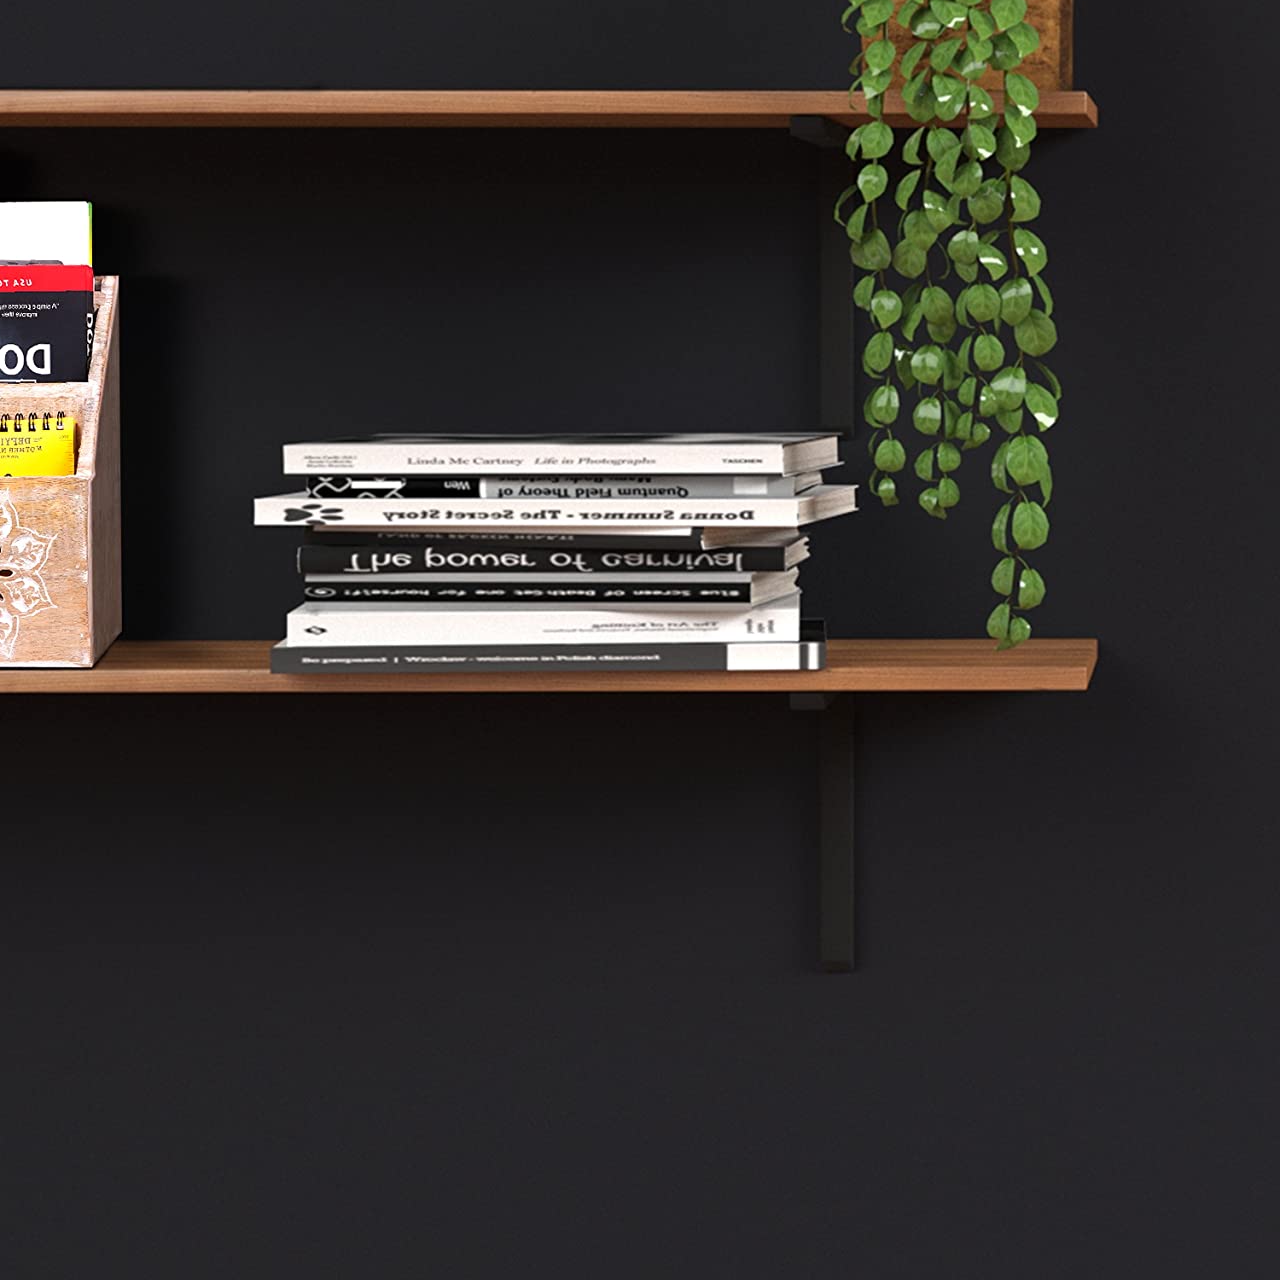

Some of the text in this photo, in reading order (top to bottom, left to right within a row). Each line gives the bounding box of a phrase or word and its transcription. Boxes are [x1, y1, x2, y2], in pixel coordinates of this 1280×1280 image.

[407, 457, 447, 465] Linda
[449, 457, 469, 465] Mc
[473, 457, 523, 466] Cartney
[534, 457, 558, 465] Life
[578, 457, 656, 466] Photographs
[443, 481, 471, 490] Wen
[497, 485, 689, 498] Quantum Field Theory of
